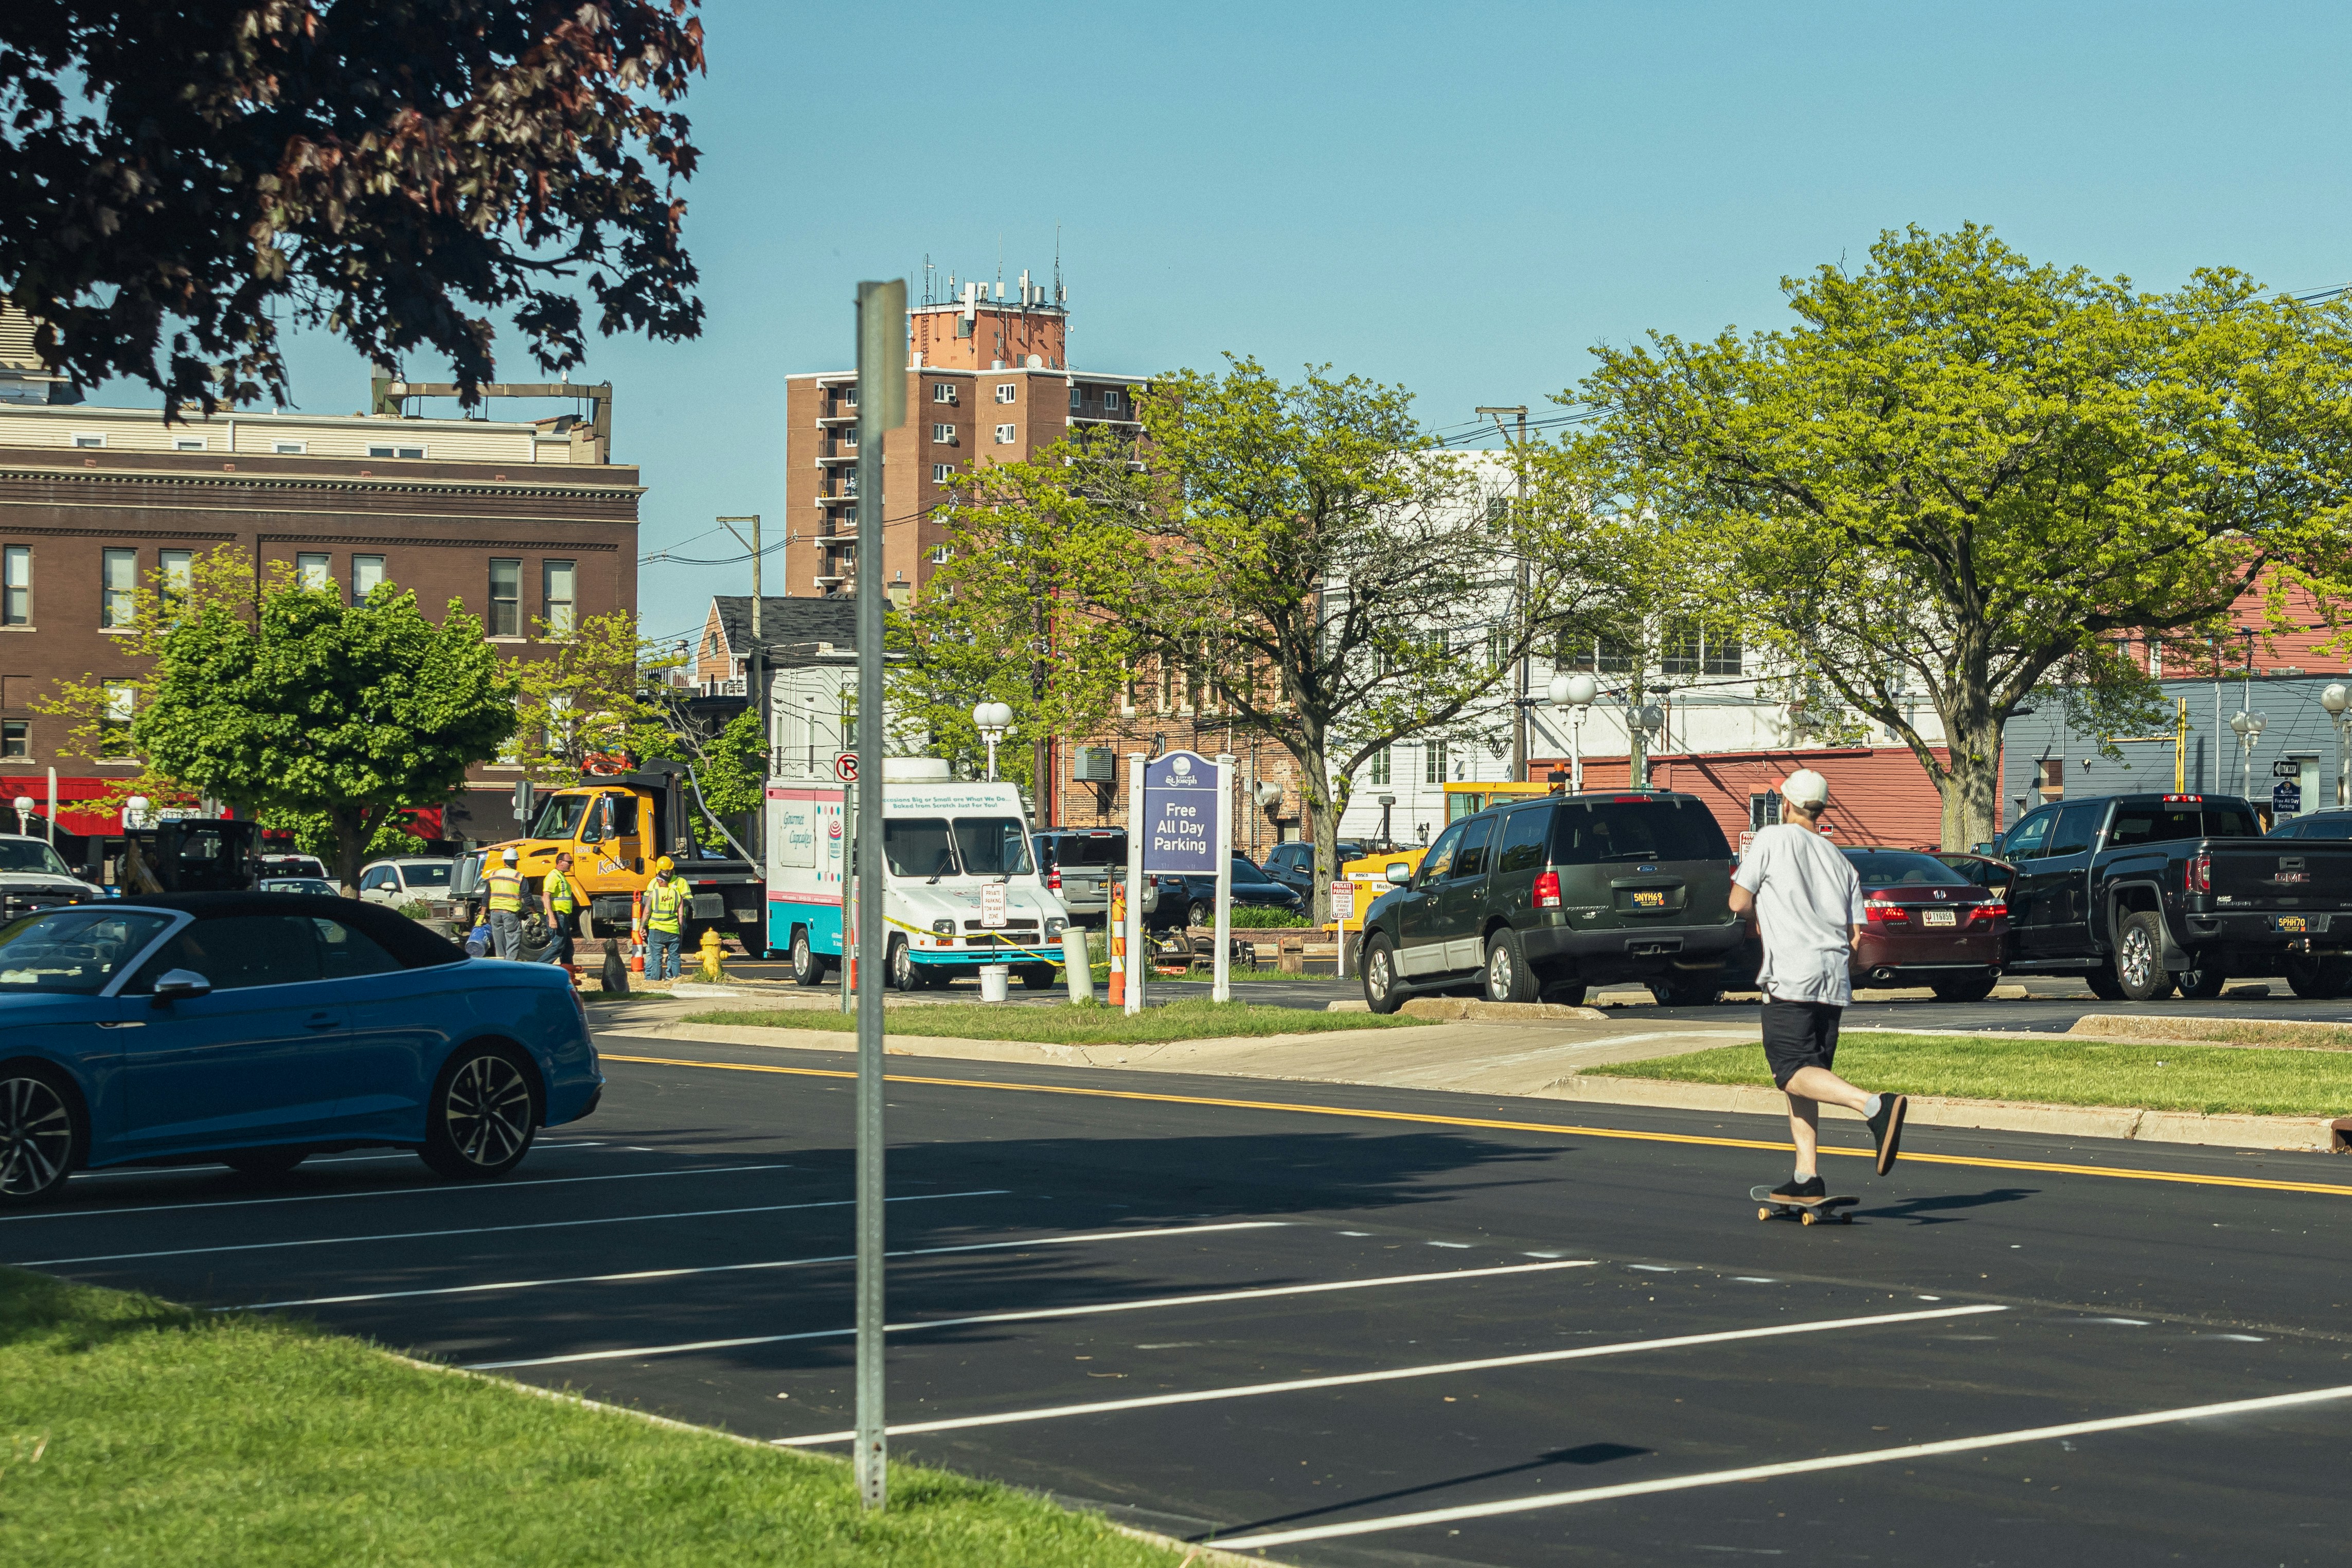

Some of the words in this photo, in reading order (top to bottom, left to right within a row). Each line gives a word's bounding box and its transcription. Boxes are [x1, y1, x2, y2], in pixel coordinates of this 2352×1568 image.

[844, 759, 858, 776] P
[1171, 775, 1198, 787] Joseph
[1166, 803, 1196, 817] Free
[1156, 820, 1176, 834] All
[1180, 821, 1204, 838] Day
[575, 845, 591, 853] 153
[1154, 836, 1206, 855] Parking
[2275, 873, 2310, 883] GMC
[1634, 892, 1663, 902] 5NYH69
[2278, 918, 2305, 926] 5PHH70
